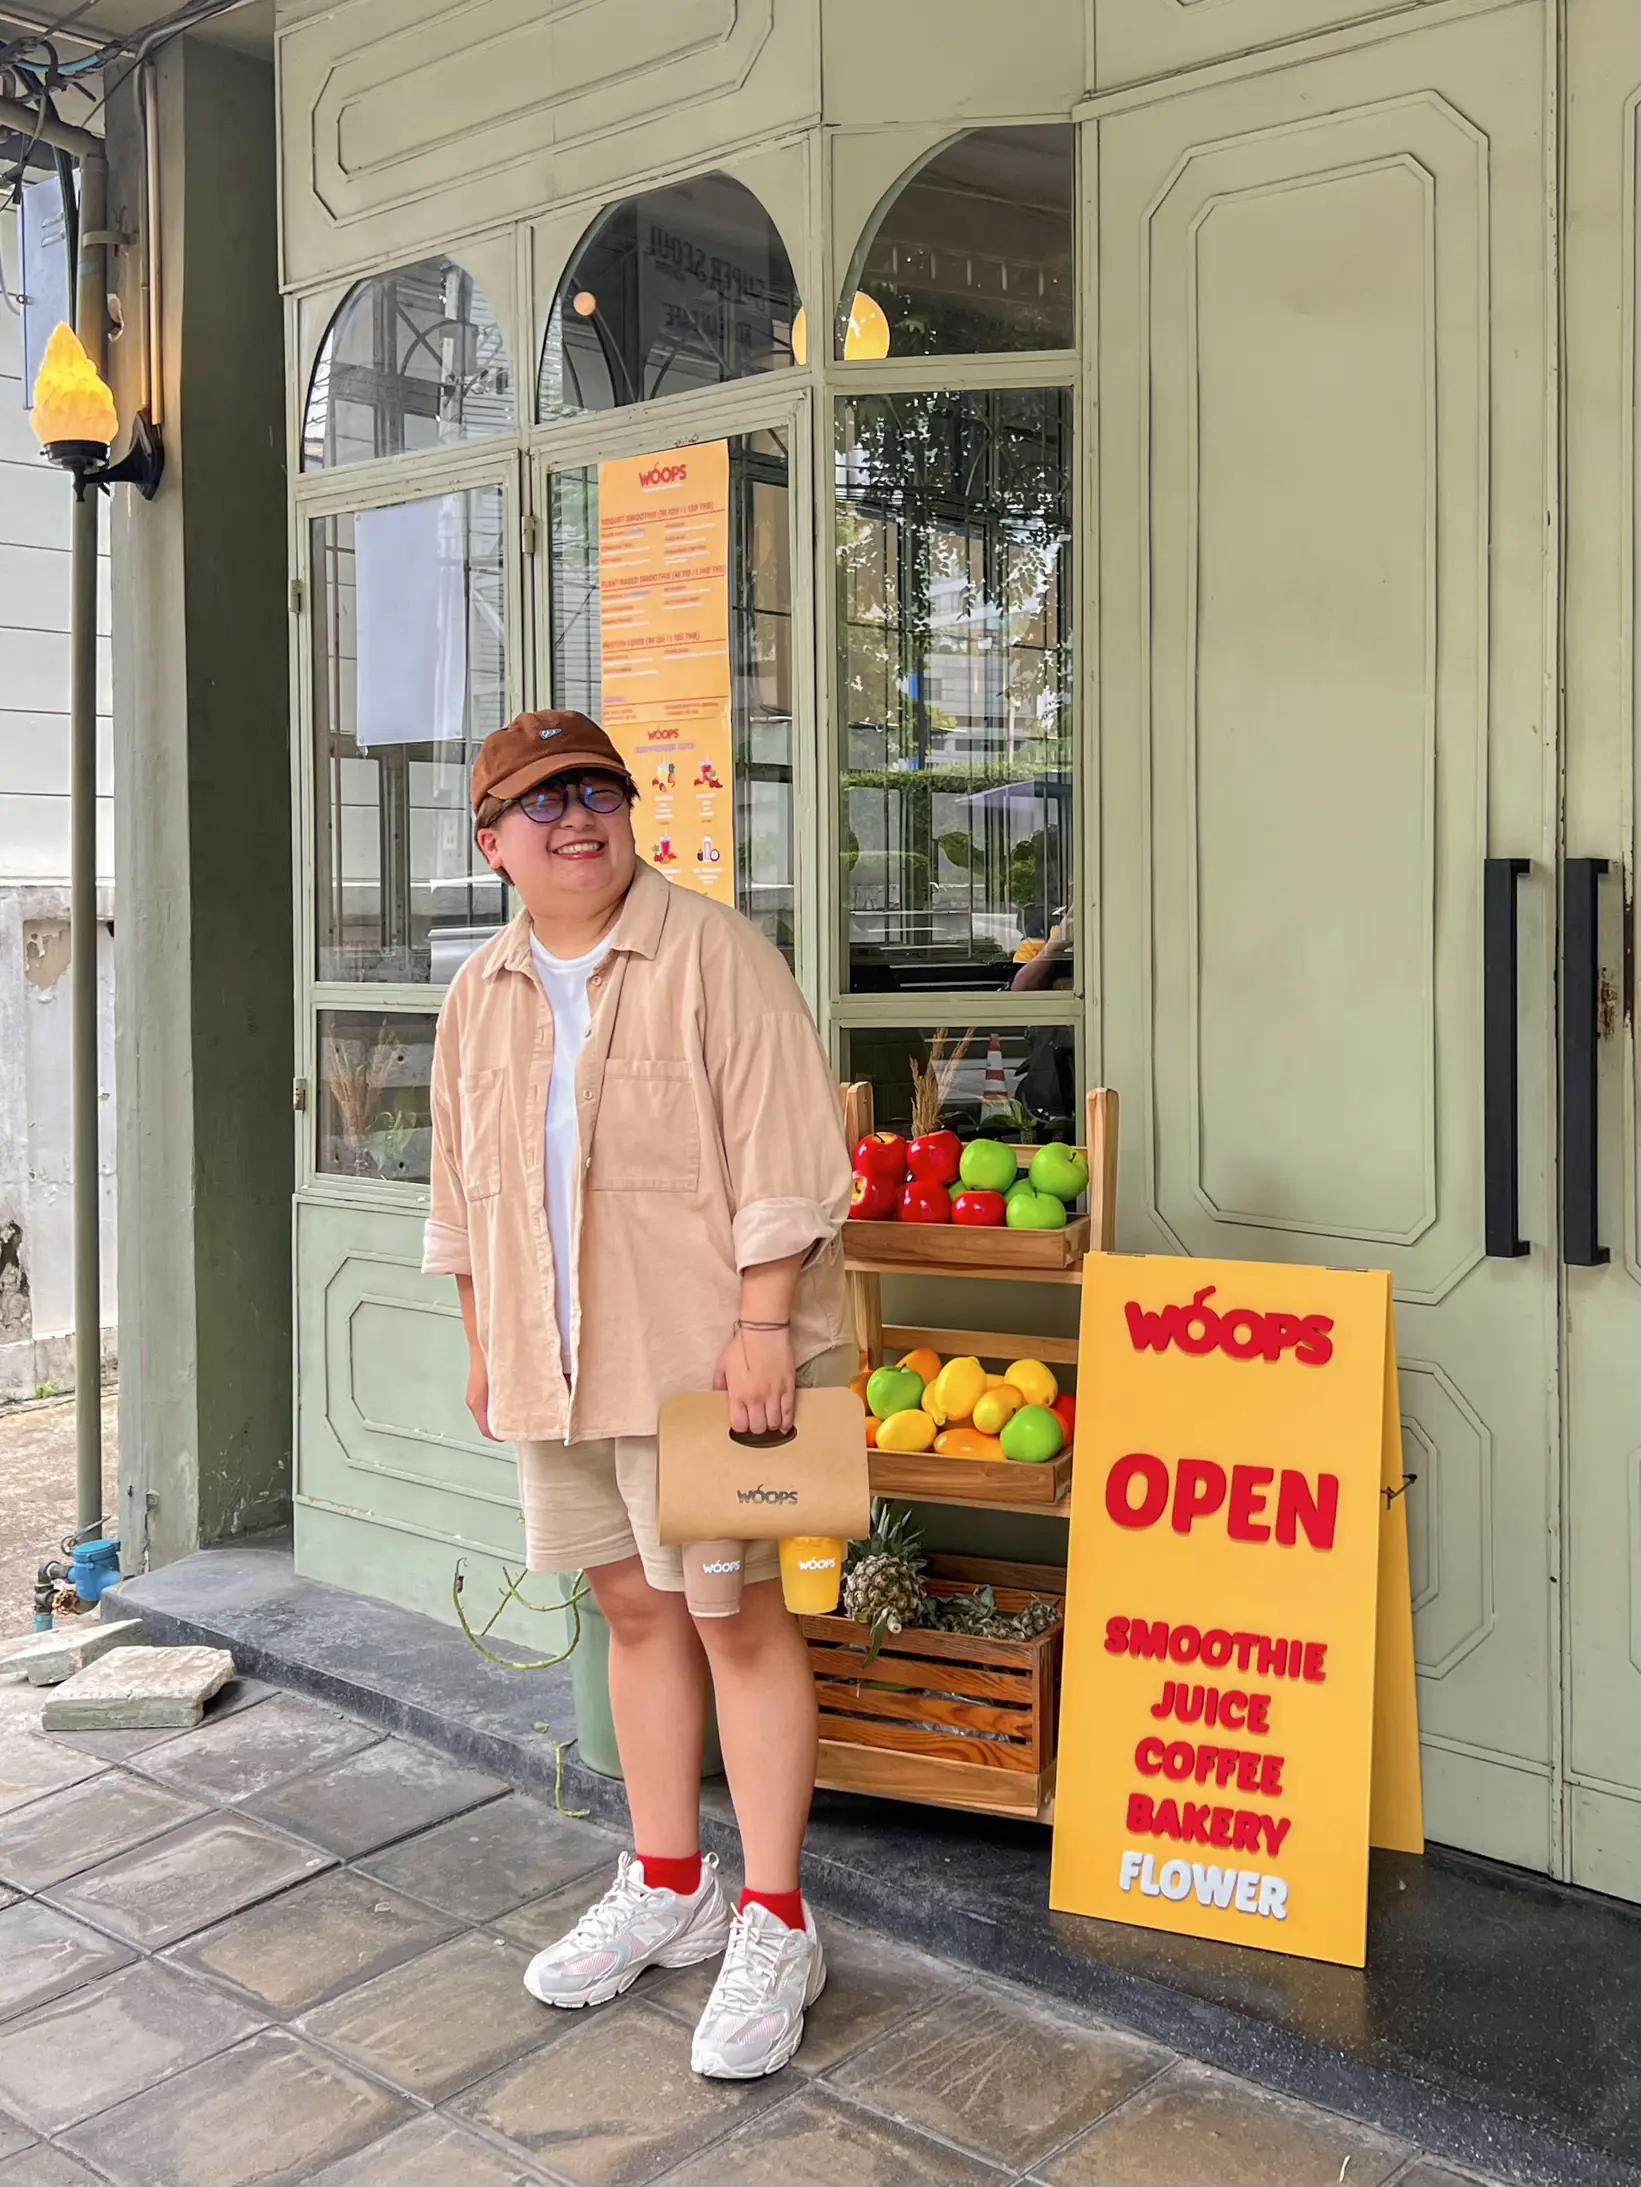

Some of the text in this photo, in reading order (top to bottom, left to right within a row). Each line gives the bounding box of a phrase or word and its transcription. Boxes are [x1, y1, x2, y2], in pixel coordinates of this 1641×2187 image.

[1105, 1453, 1340, 1552] OPEN
[1104, 1616, 1328, 1684] SMOOTHIE
[1151, 1681, 1271, 1736] JUICE
[1135, 1736, 1285, 1797] COFFEE
[1126, 1793, 1292, 1858] BAKERY
[1119, 1851, 1290, 1921] FLOWER
